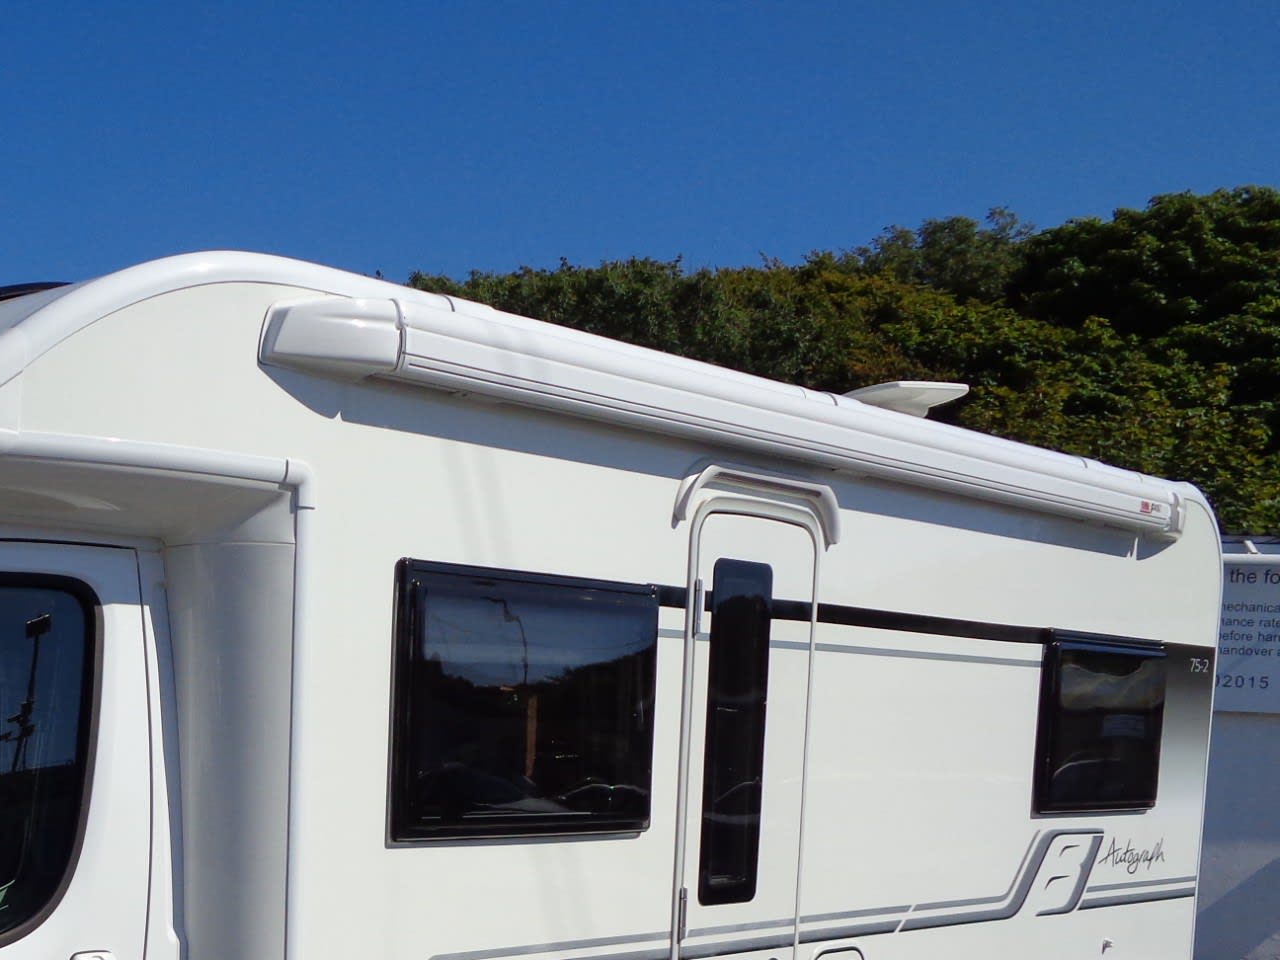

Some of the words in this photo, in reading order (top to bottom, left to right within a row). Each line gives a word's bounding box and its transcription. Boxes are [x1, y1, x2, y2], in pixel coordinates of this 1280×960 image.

[1230, 568, 1257, 584] the
[1190, 657, 1209, 673] 75-2
[1097, 837, 1166, 875] Autograph
